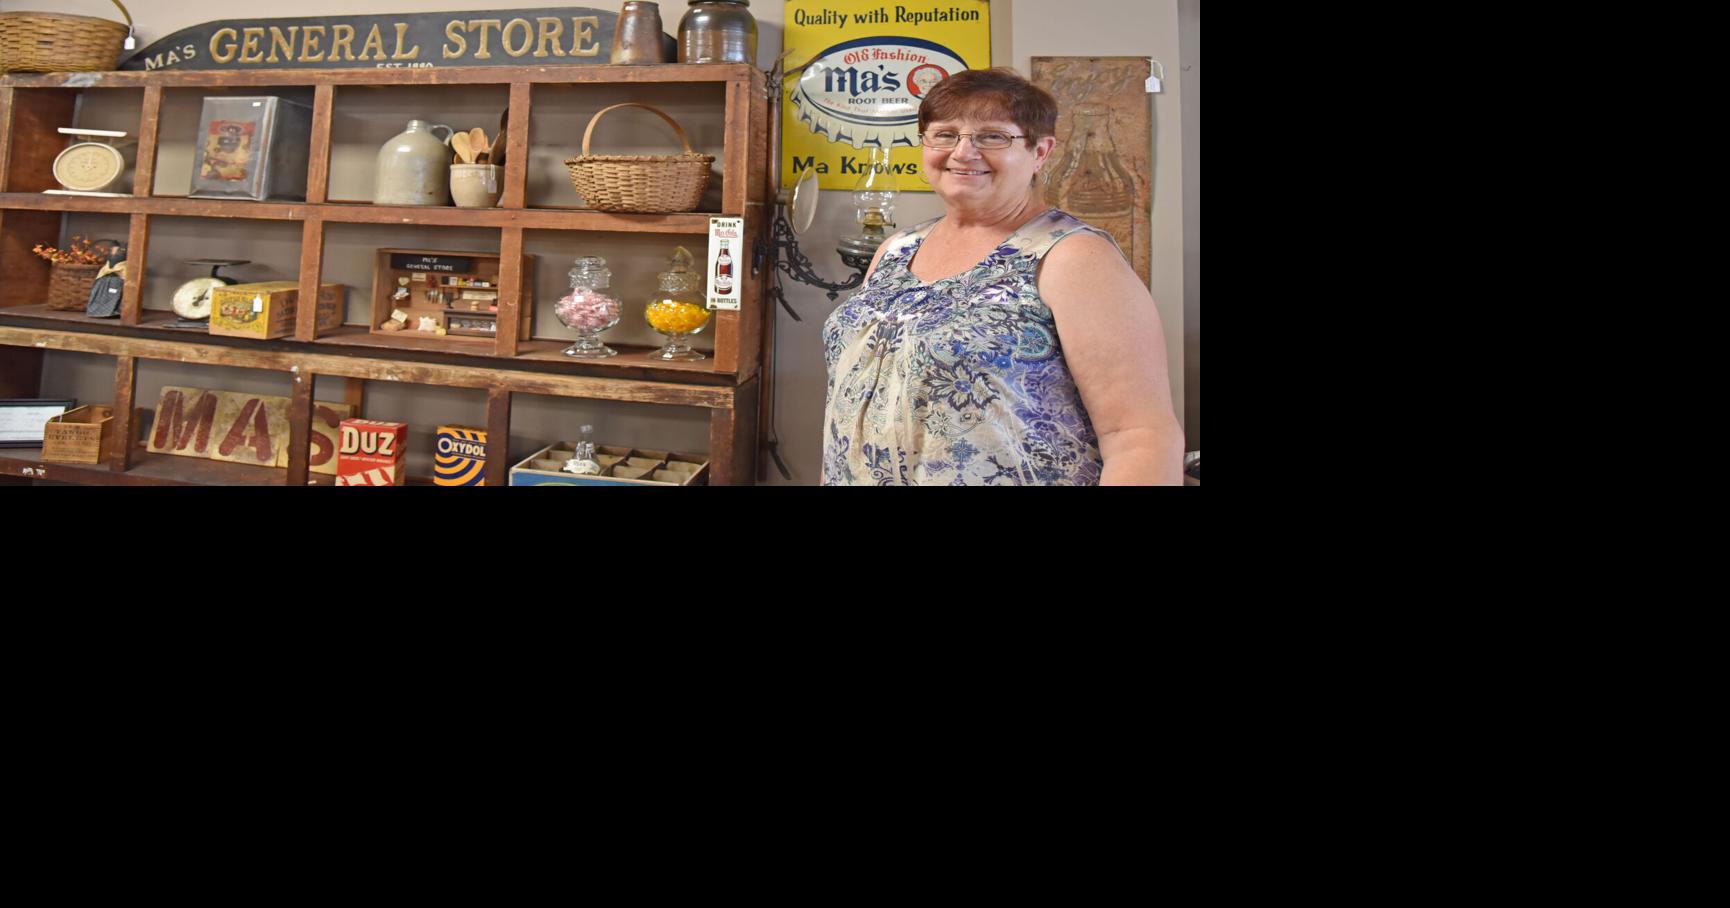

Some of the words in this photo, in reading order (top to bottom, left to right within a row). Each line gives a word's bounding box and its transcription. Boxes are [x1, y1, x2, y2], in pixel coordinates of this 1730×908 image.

[794, 8, 847, 28] Quality
[854, 8, 889, 24] with
[895, 6, 979, 26] Reputation
[144, 44, 196, 71] MA'S
[208, 23, 419, 64] GENERAL
[442, 16, 600, 59] STORE
[844, 48, 870, 65] Old
[872, 47, 927, 63] Fashion
[820, 64, 901, 97] Ma's
[848, 97, 876, 105] ROOT
[792, 156, 828, 174] Ma
[840, 156, 918, 175] Knows
[340, 425, 396, 456] DUZ
[437, 437, 486, 457] OXYDOL
